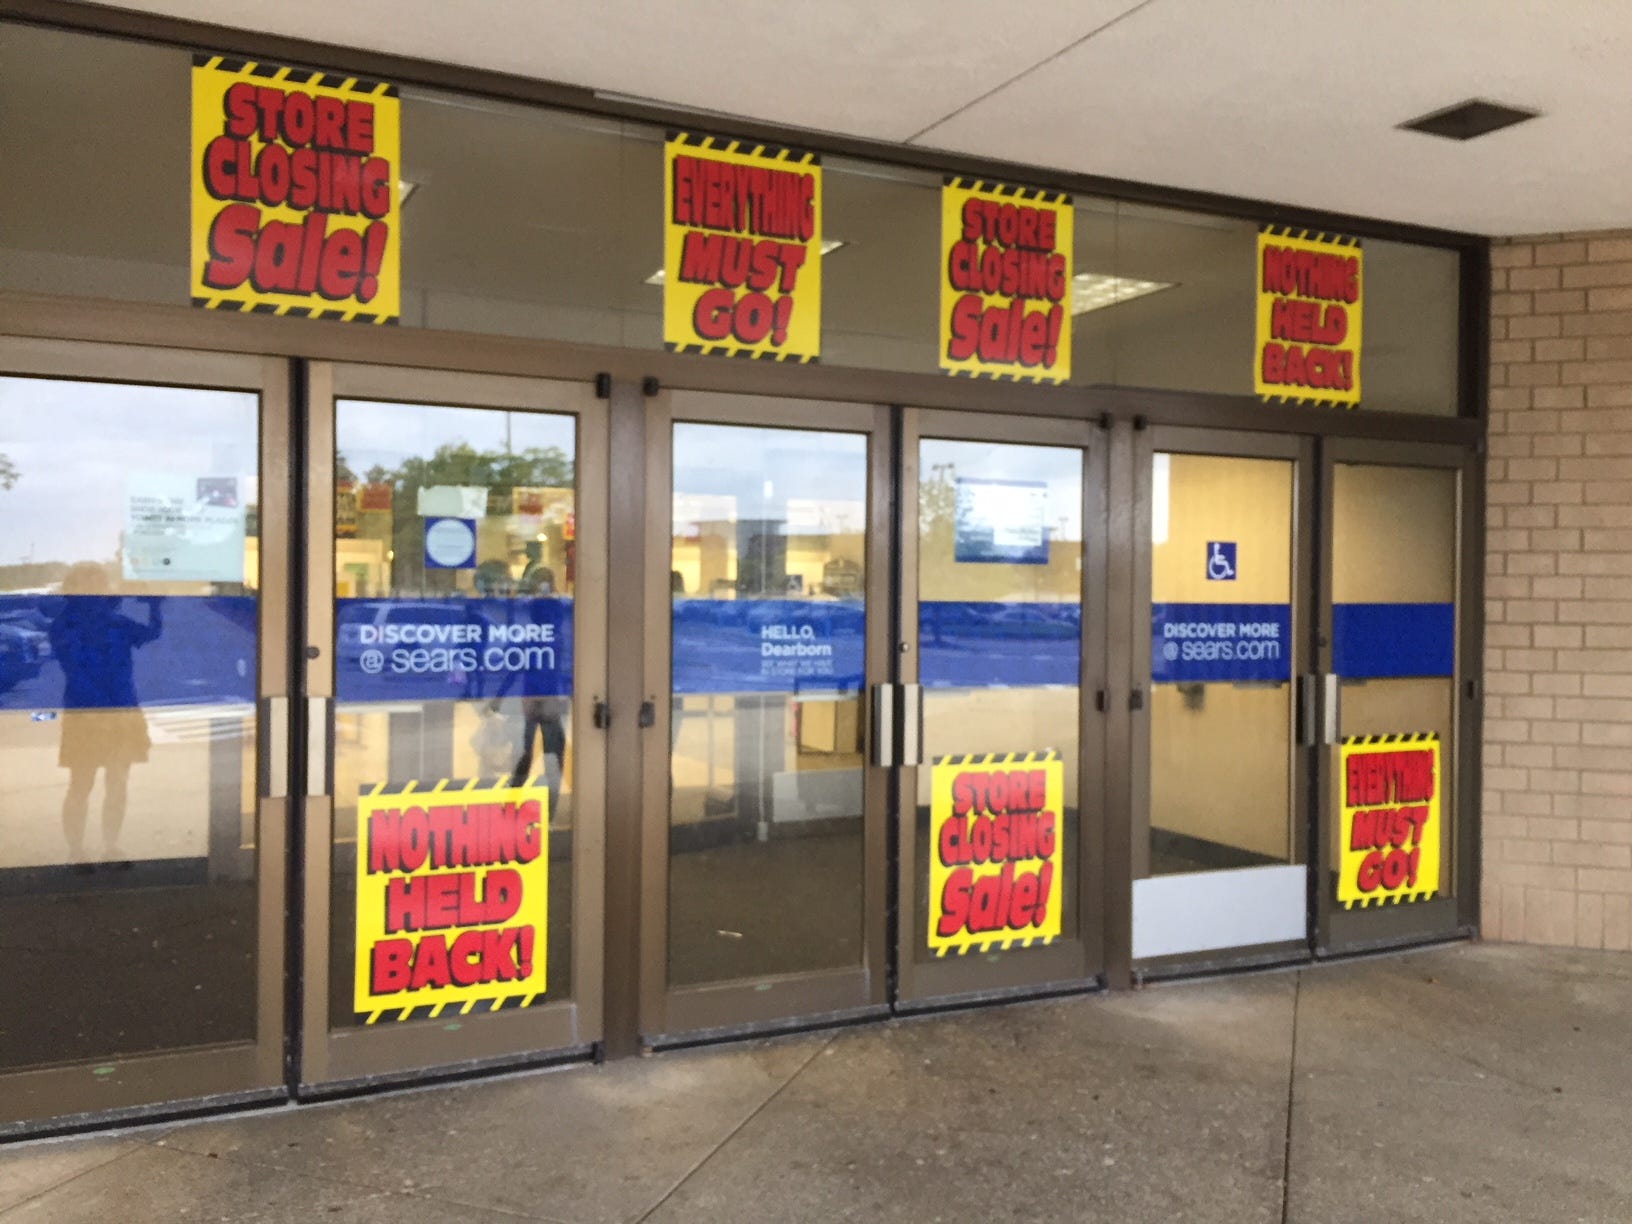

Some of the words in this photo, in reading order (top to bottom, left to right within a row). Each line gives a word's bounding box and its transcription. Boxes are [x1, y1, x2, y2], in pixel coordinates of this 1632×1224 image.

[224, 82, 375, 155] STORE
[204, 136, 390, 219] CLOSING
[673, 155, 814, 241] EVERYTHING
[203, 203, 389, 303] Sale!
[962, 197, 1056, 252] STORE
[679, 231, 807, 293] MUST
[949, 241, 1066, 301] CLOSING
[1263, 244, 1359, 304] NOTHING
[693, 288, 794, 347] GO!
[949, 295, 1064, 368] Sale!
[1272, 297, 1347, 345] HELD
[1262, 342, 1353, 391] BACK!
[360, 624, 482, 644] DISCOVER
[489, 624, 555, 643] MORE
[761, 625, 815, 640] HELLO,
[761, 642, 832, 657] Dearborn
[1163, 622, 1236, 639] DISCOVER
[1239, 622, 1280, 638] MORE
[1181, 640, 1280, 661] sears.com
[360, 649, 384, 674] @
[391, 646, 555, 673] sears.com
[952, 769, 1047, 817] STORE
[367, 799, 542, 876] NOTHING
[938, 810, 1056, 867] CLOSING
[1350, 805, 1430, 853] MUST
[936, 860, 1054, 937] Sale!
[1356, 846, 1421, 893] GO!
[384, 867, 524, 936] HELD
[369, 923, 535, 997] BACK!
